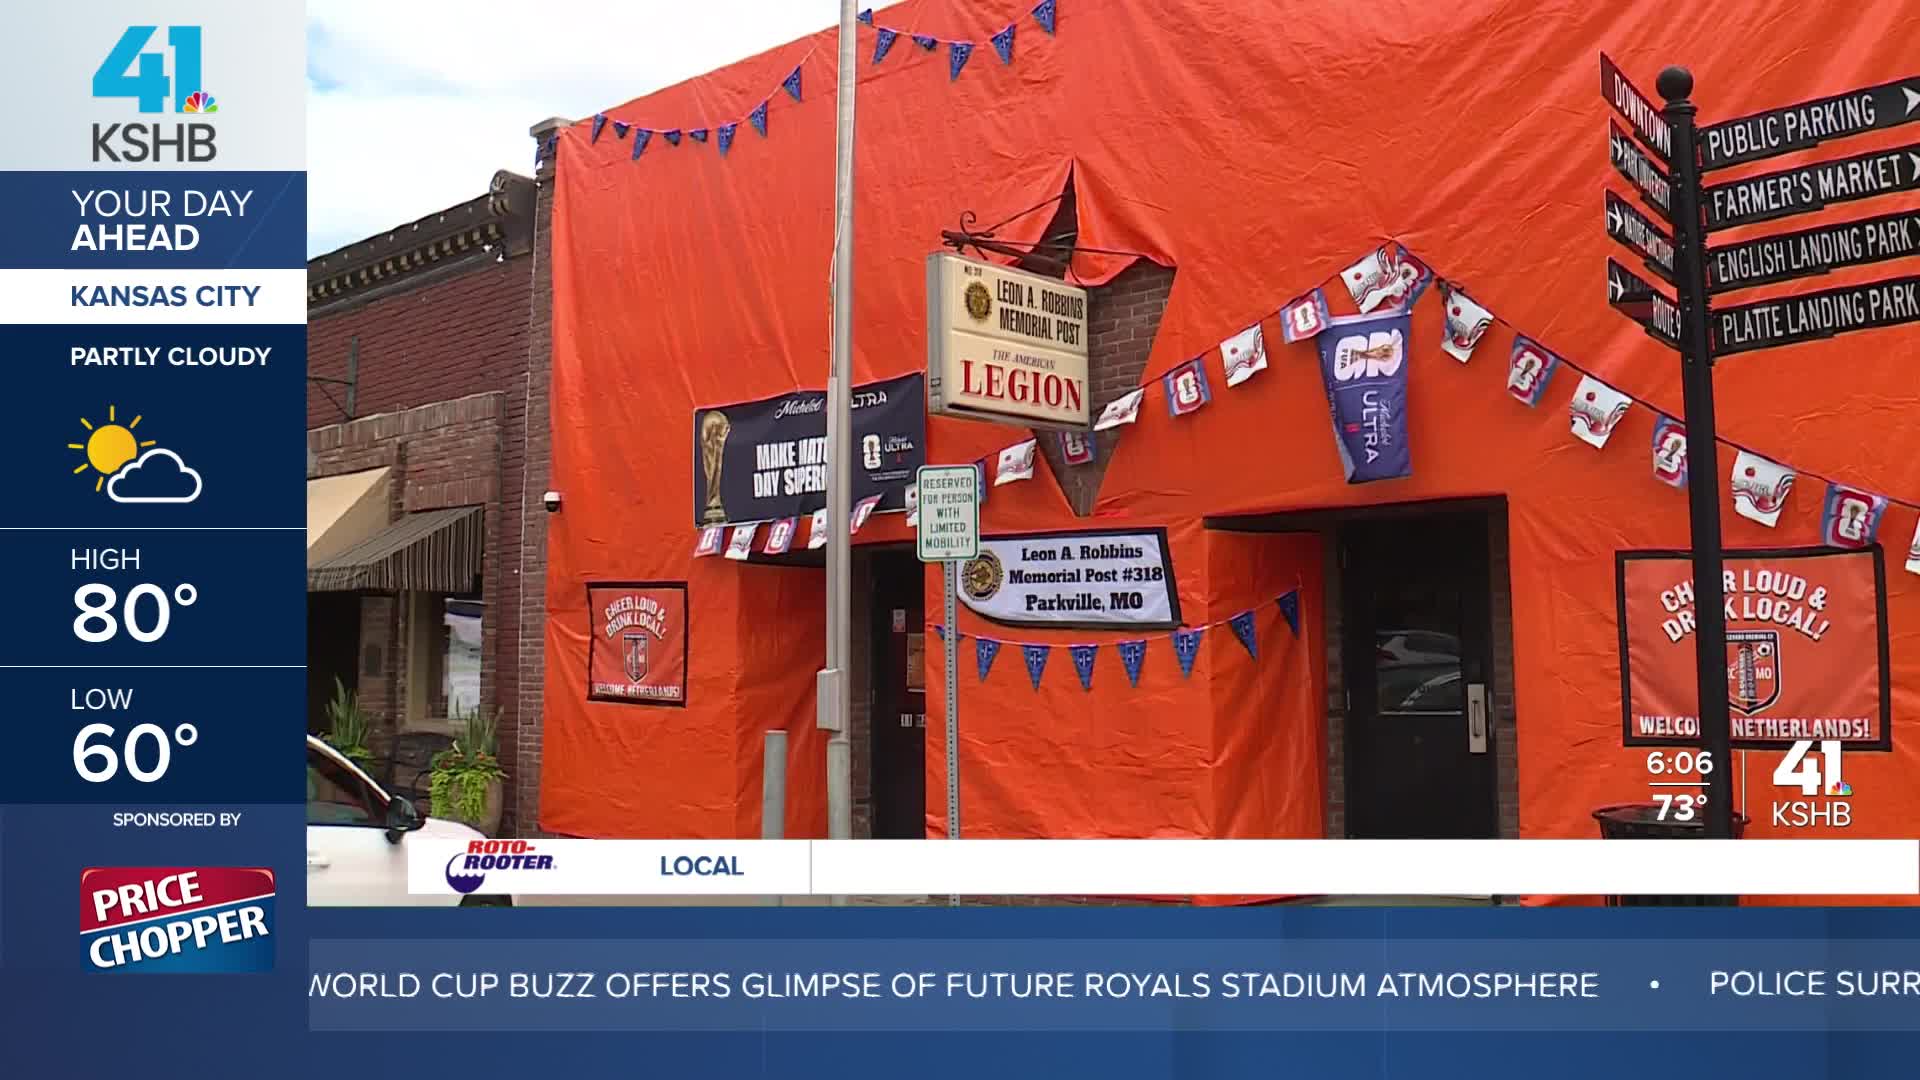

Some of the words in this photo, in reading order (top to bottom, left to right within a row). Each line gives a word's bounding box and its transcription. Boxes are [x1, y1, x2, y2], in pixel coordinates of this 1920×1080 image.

[1614, 73, 1672, 158] DOWNTOWN
[1709, 122, 1780, 161] PUBLIC
[1786, 94, 1876, 142] PARKING
[1713, 171, 1812, 221] FARMER'S
[1817, 154, 1901, 201] MARKET
[1718, 242, 1785, 283] ENGLISH
[1790, 225, 1862, 270] LANDING
[1866, 217, 1912, 257] PARK
[997, 279, 1023, 307] LEON
[1027, 286, 1038, 310] A.
[1042, 289, 1083, 320] ROBBINS
[1722, 304, 1784, 345] PLATTE
[1788, 291, 1864, 335] LANDING
[1870, 282, 1919, 321] PARK
[1000, 307, 1053, 340] MEMORIAL
[1057, 319, 1080, 346] POST
[1653, 295, 1676, 339] ROUTE
[1675, 308, 1682, 340] 9
[1012, 353, 1056, 369] AMERICAN
[960, 359, 1083, 411] LEGION
[850, 391, 888, 409] LTRA
[1363, 390, 1379, 464] ULTRA
[756, 441, 796, 471] MAKE
[885, 442, 914, 452] ULTRA
[753, 469, 780, 498] DAY
[923, 477, 973, 489] RESERVED
[923, 494, 939, 505] FOR
[942, 492, 973, 504] PERSON
[936, 507, 960, 519] WITH
[925, 536, 971, 549] MOBILITY
[930, 522, 966, 534] LIMITED
[1021, 547, 1057, 562] Leon
[1059, 545, 1076, 561] A.
[1080, 544, 1143, 560] Robbins
[1009, 568, 1081, 585] Memorial
[1085, 567, 1118, 583] Post
[1122, 566, 1163, 582] #318
[1025, 593, 1106, 613] Parkville,
[1110, 591, 1143, 611] MO
[1661, 570, 1737, 612] CHR
[1743, 569, 1807, 601] LOUD
[1808, 586, 1828, 611] &
[605, 596, 633, 621] CHEER
[635, 595, 657, 616] LOUD
[657, 608, 665, 623] &
[1662, 598, 1738, 642] DRK
[1743, 595, 1830, 641] LOCAL!
[605, 612, 632, 638] DRINK
[635, 611, 667, 640] LOCAL!
[1639, 715, 1700, 737] WELCO
[1732, 717, 1871, 739] NETHERLANDS!
